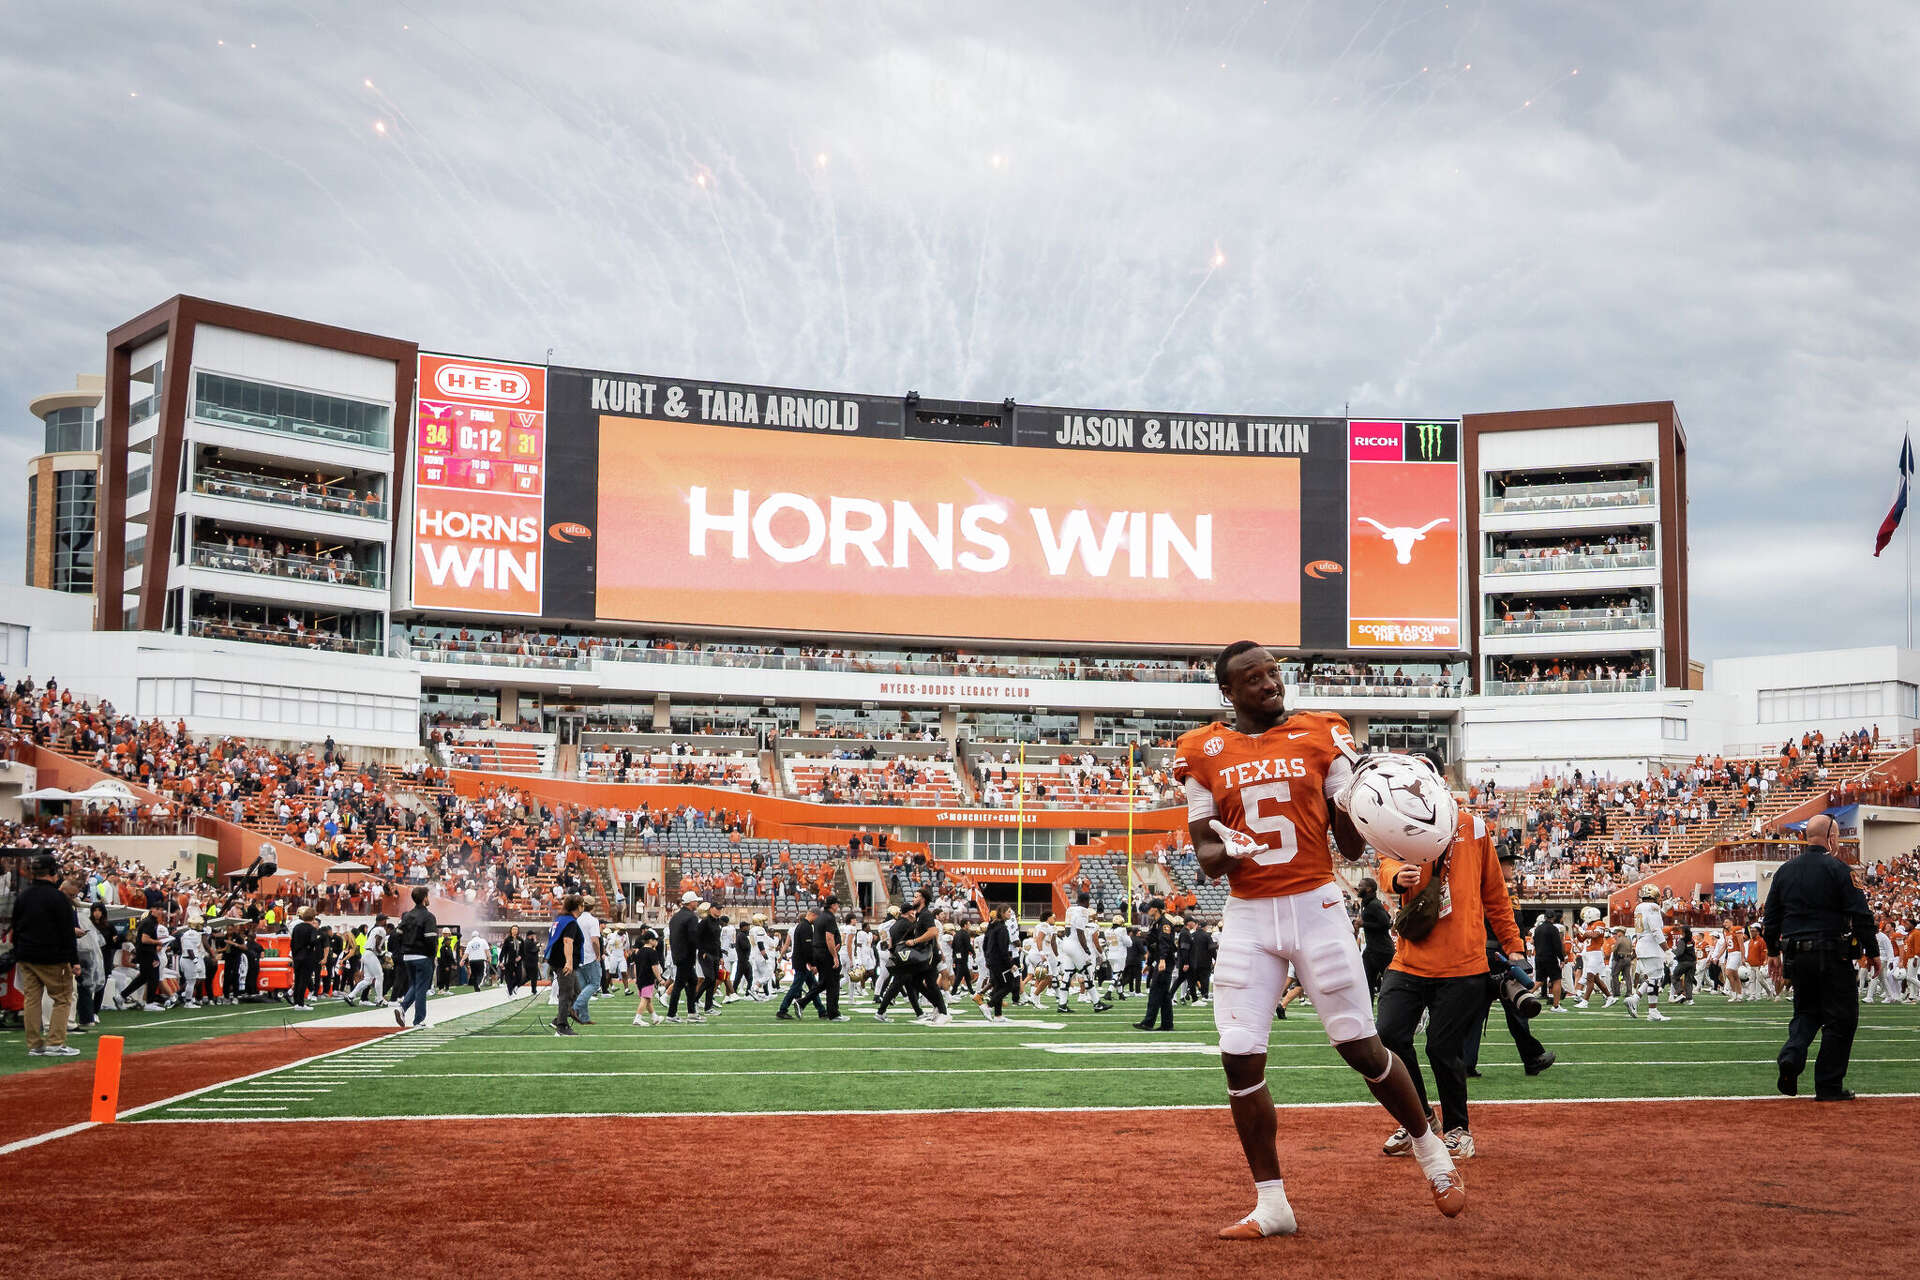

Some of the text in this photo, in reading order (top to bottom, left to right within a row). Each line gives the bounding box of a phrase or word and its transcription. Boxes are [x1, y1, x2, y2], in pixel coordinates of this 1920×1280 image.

[591, 378, 859, 431] KURT & TARA ARNOLD
[426, 424, 447, 446] 34
[460, 426, 502, 453] 0:12
[518, 434, 536, 454] 31
[1056, 415, 1310, 453] JASON & KISHA ITKIN
[1354, 436, 1399, 447] RICOH
[419, 508, 538, 543] HORNS
[688, 485, 1212, 580] HORNS WIN
[420, 543, 537, 592] WIN
[1358, 625, 1450, 635] SCORES AROUND
[1374, 632, 1435, 642] THE TOP 25
[961, 684, 999, 697] LEGACY
[1005, 687, 1030, 698] CLUB
[1205, 739, 1223, 754] SEC
[1219, 758, 1307, 789] TEXAS
[936, 812, 949, 822] TEX
[1240, 781, 1298, 866] 5
[1027, 868, 1047, 877] FIELD
[260, 977, 269, 987] G
